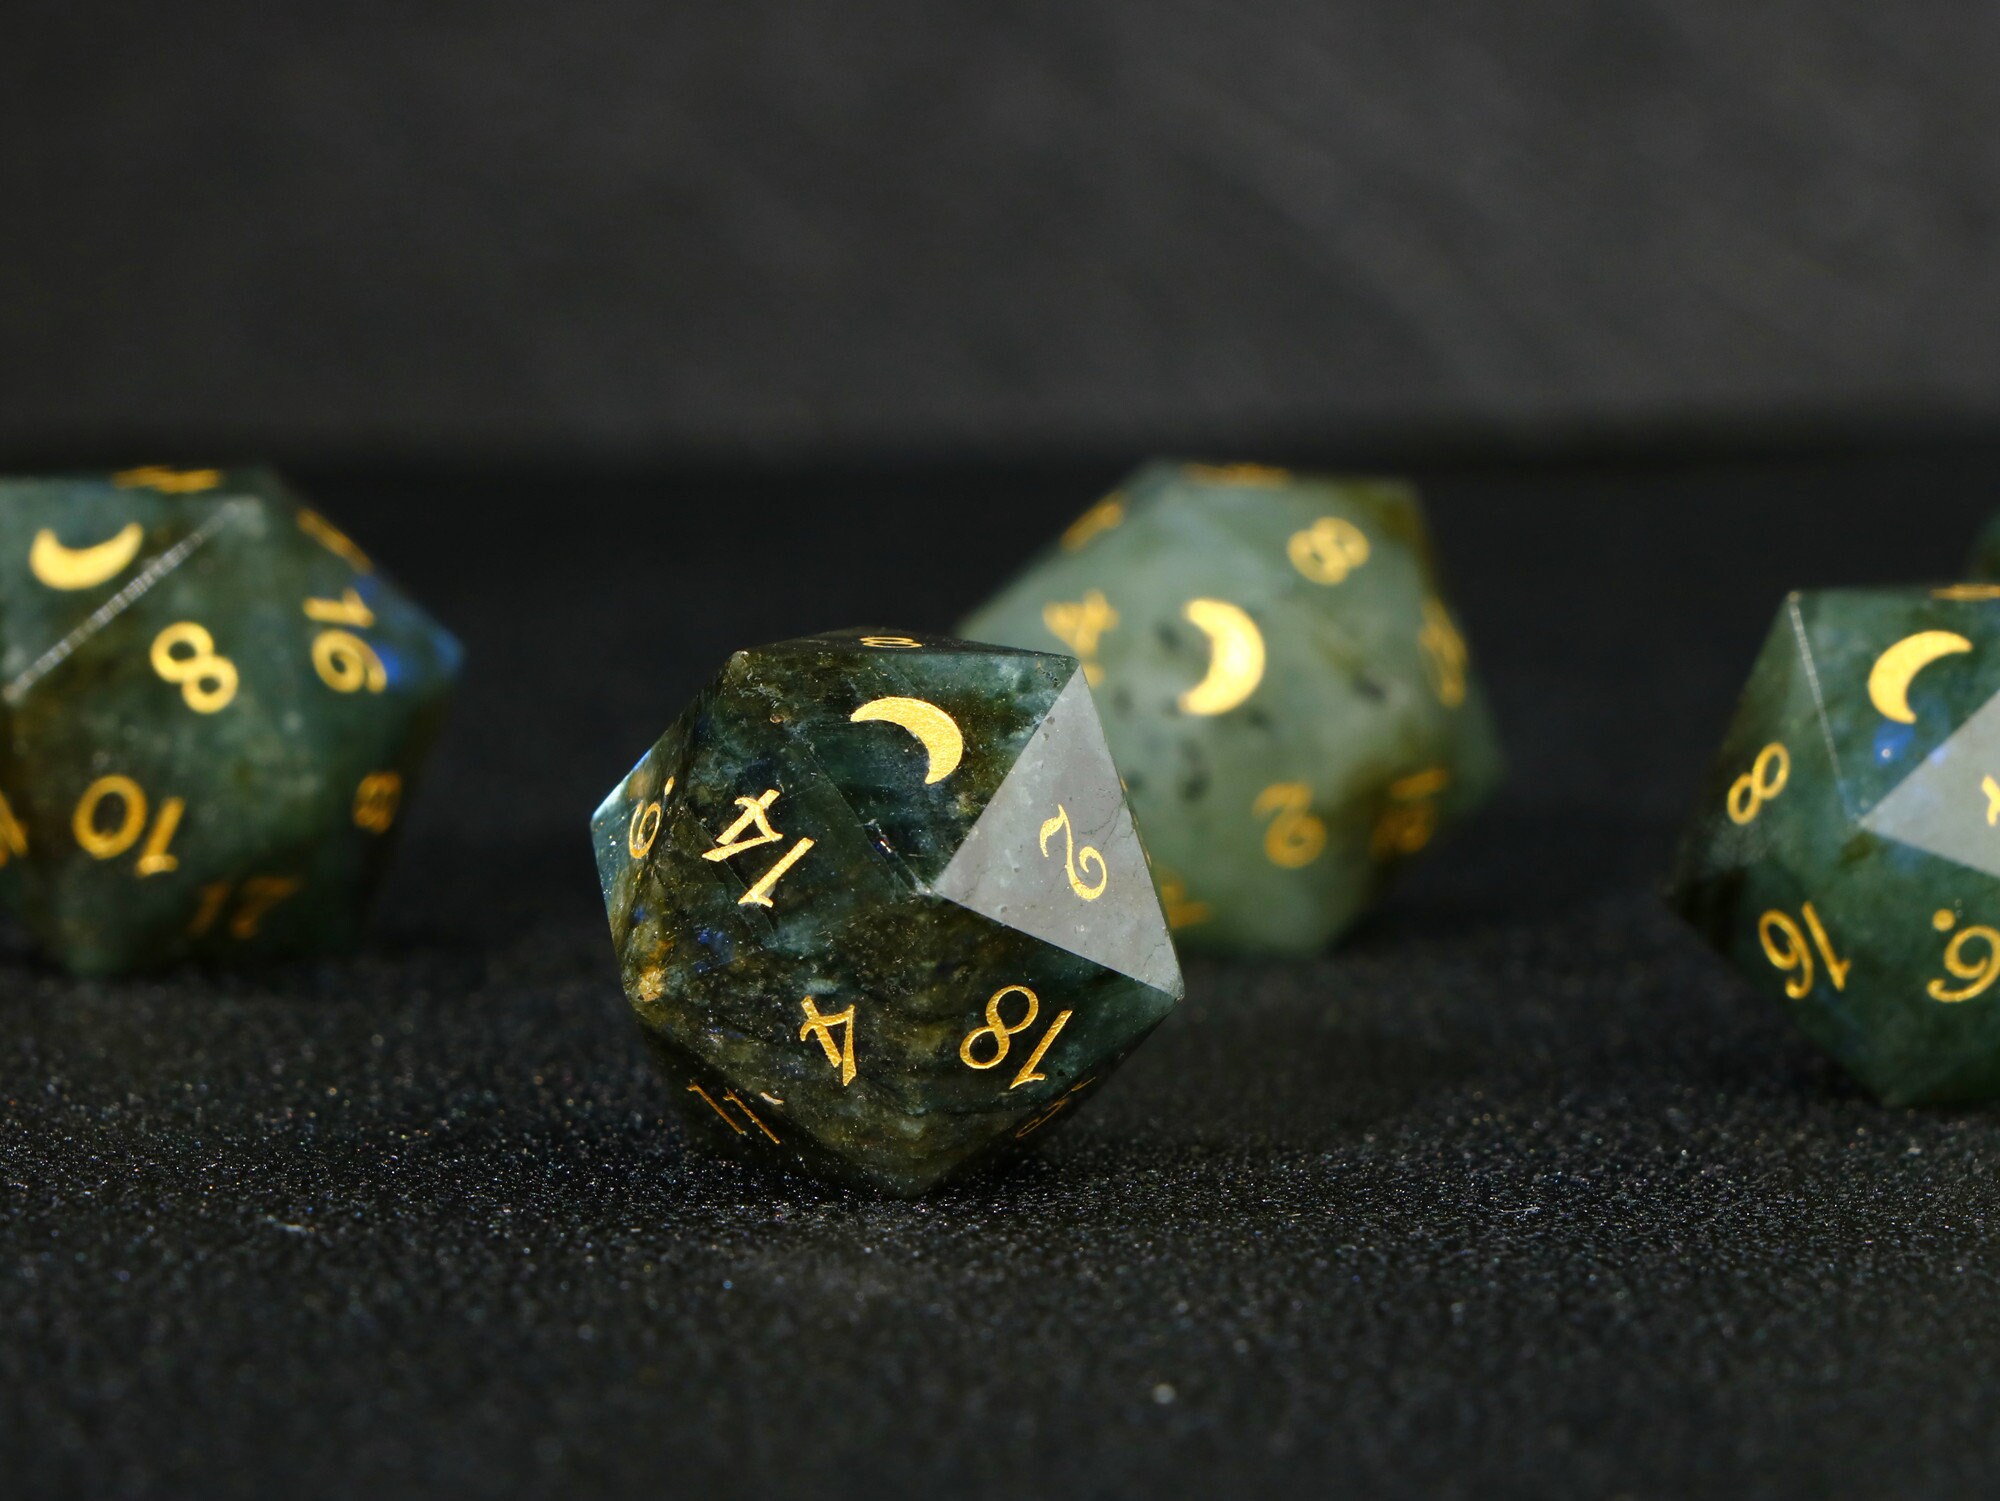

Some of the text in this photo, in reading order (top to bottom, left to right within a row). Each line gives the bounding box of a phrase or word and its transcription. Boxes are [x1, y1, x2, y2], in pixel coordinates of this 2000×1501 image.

[150, 621, 239, 714] 8
[72, 774, 185, 877] 10
[1727, 742, 1790, 825] 8
[701, 788, 815, 909] 14
[1038, 803, 1109, 901] 2
[1758, 901, 1850, 999] 16
[799, 995, 857, 1086] 4
[959, 984, 1072, 1090] 18
